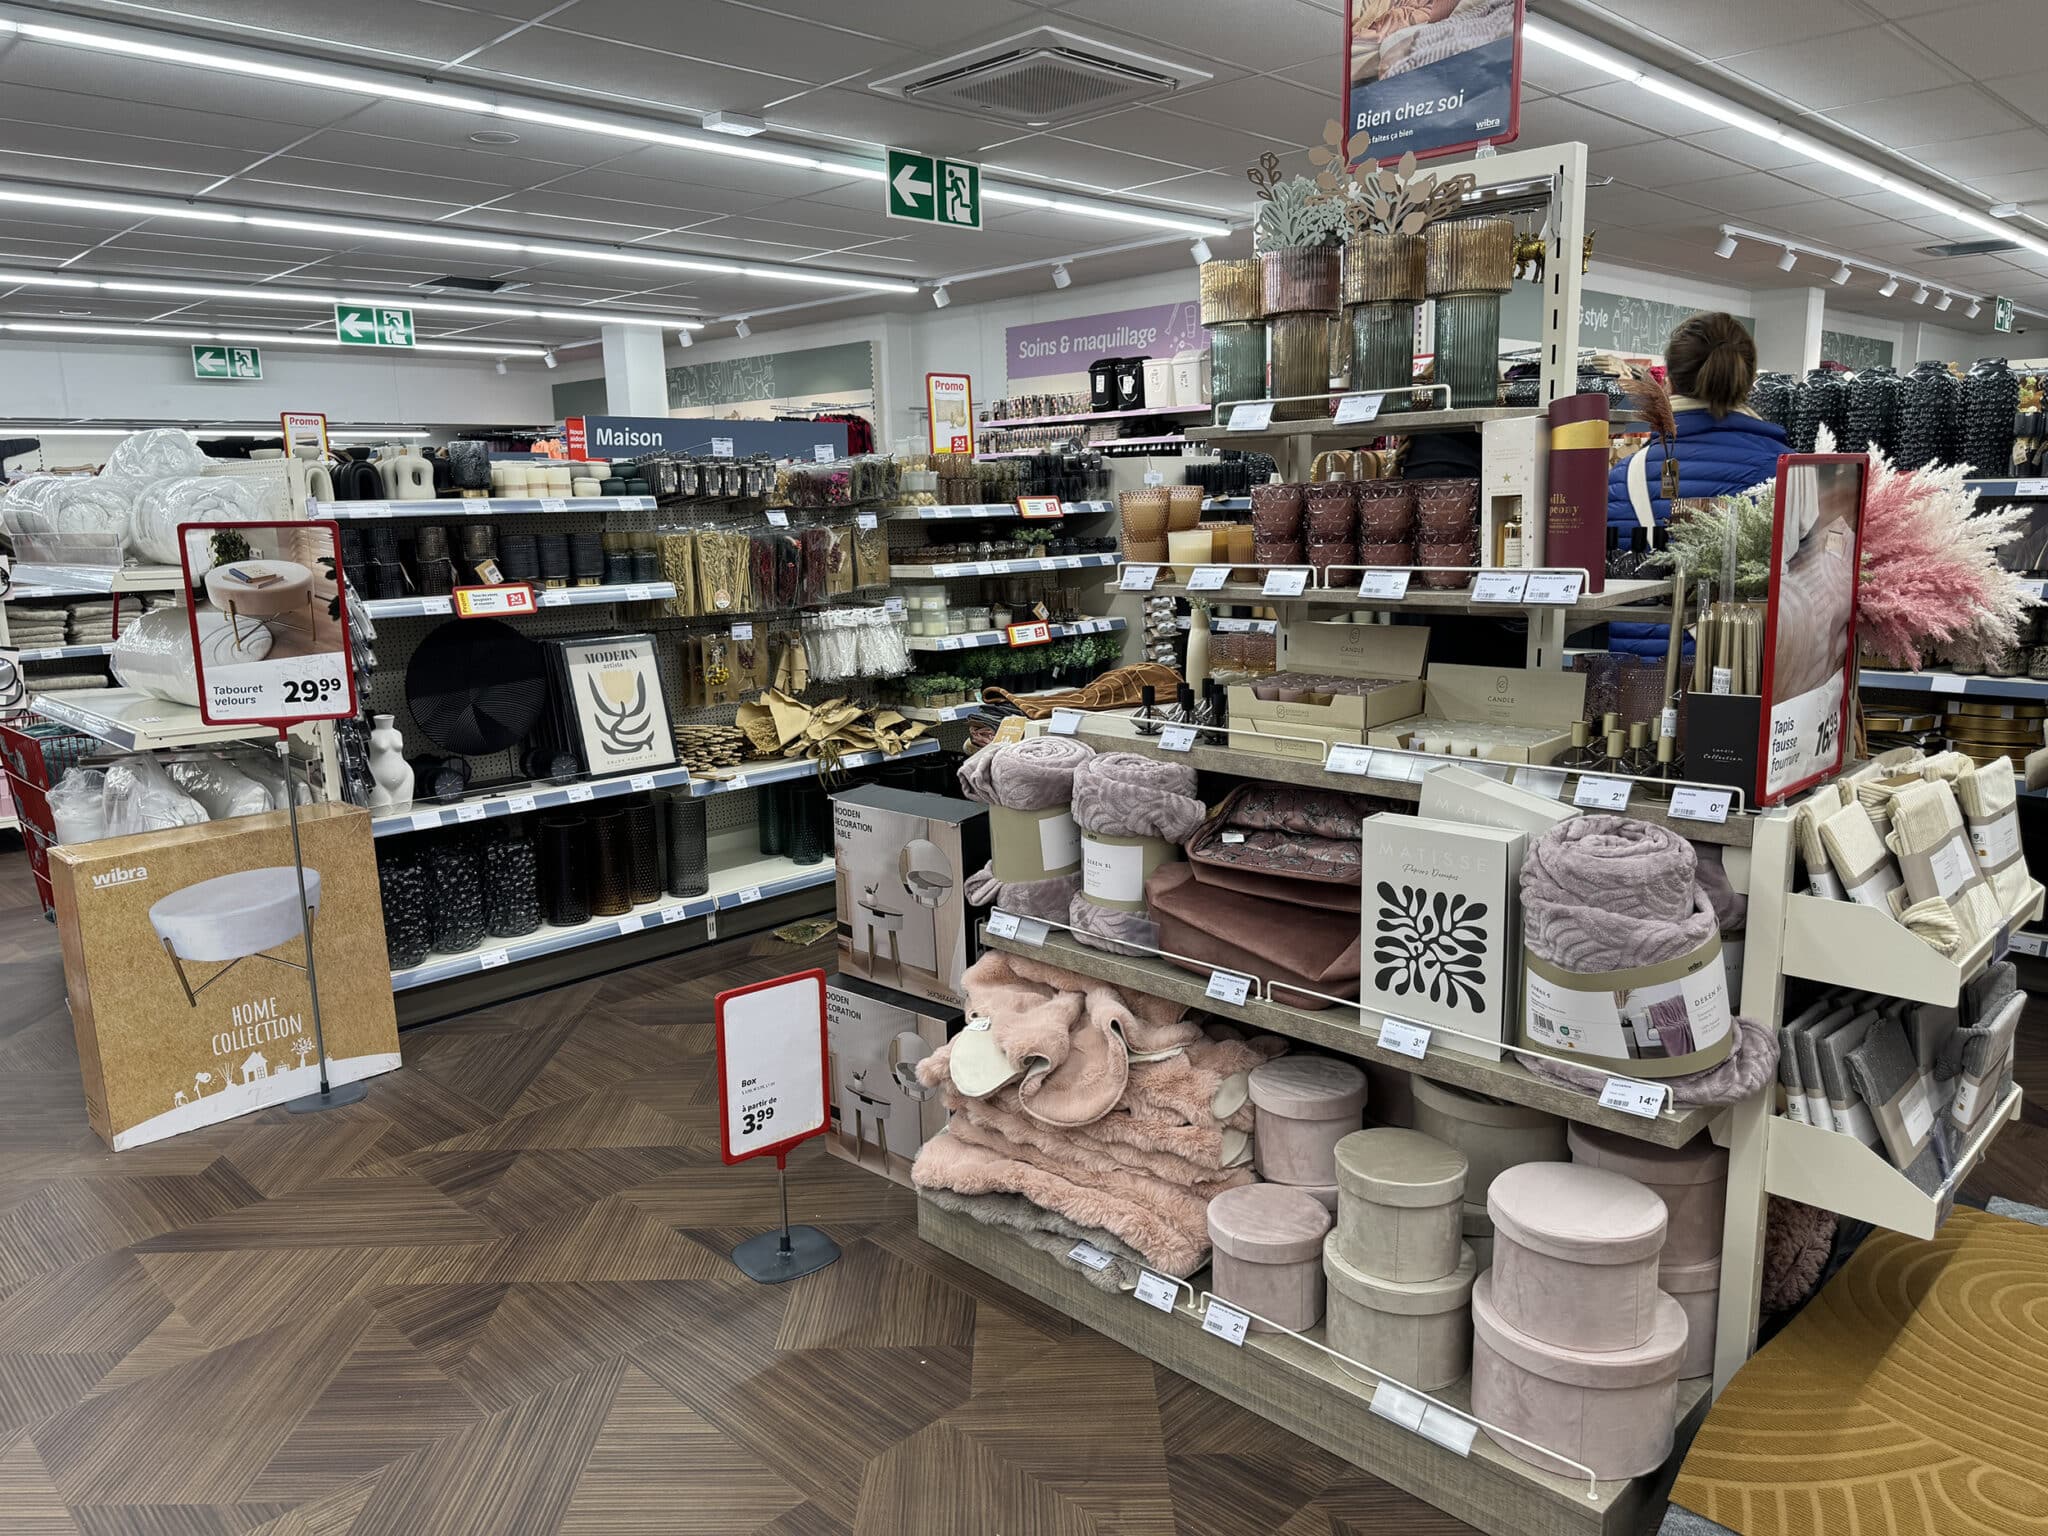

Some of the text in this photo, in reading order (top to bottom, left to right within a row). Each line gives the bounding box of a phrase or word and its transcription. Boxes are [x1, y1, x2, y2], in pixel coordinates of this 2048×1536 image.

[1356, 88, 1465, 130] Bien chez soi
[1475, 117, 1500, 130] wibra
[1371, 128, 1414, 144] faites ça bien
[1584, 307, 1609, 332] style
[1019, 327, 1157, 359] Soins & maquillage
[935, 380, 965, 391] Promo
[289, 416, 320, 426] Promo
[596, 427, 663, 447] Maison
[584, 649, 638, 664] MODERN
[213, 684, 264, 695] Tabouret
[283, 678, 342, 703] 29.99
[214, 696, 257, 706] velours
[1487, 695, 1515, 704] CANDLE
[1775, 716, 1795, 736] Tapis
[1772, 736, 1798, 756] fausse
[1770, 752, 1801, 775] fourrure
[1378, 840, 1489, 873] MATISSE
[92, 866, 148, 888] wibra
[825, 991, 850, 1006] OODEN
[231, 997, 278, 1027] HOME
[827, 1014, 840, 1025] BLE
[828, 1003, 862, 1020] CORATION
[212, 1013, 303, 1057] COLLECTION
[741, 1078, 757, 1088] Box
[742, 1096, 777, 1113] à partir de
[742, 1107, 774, 1135] 3.99
